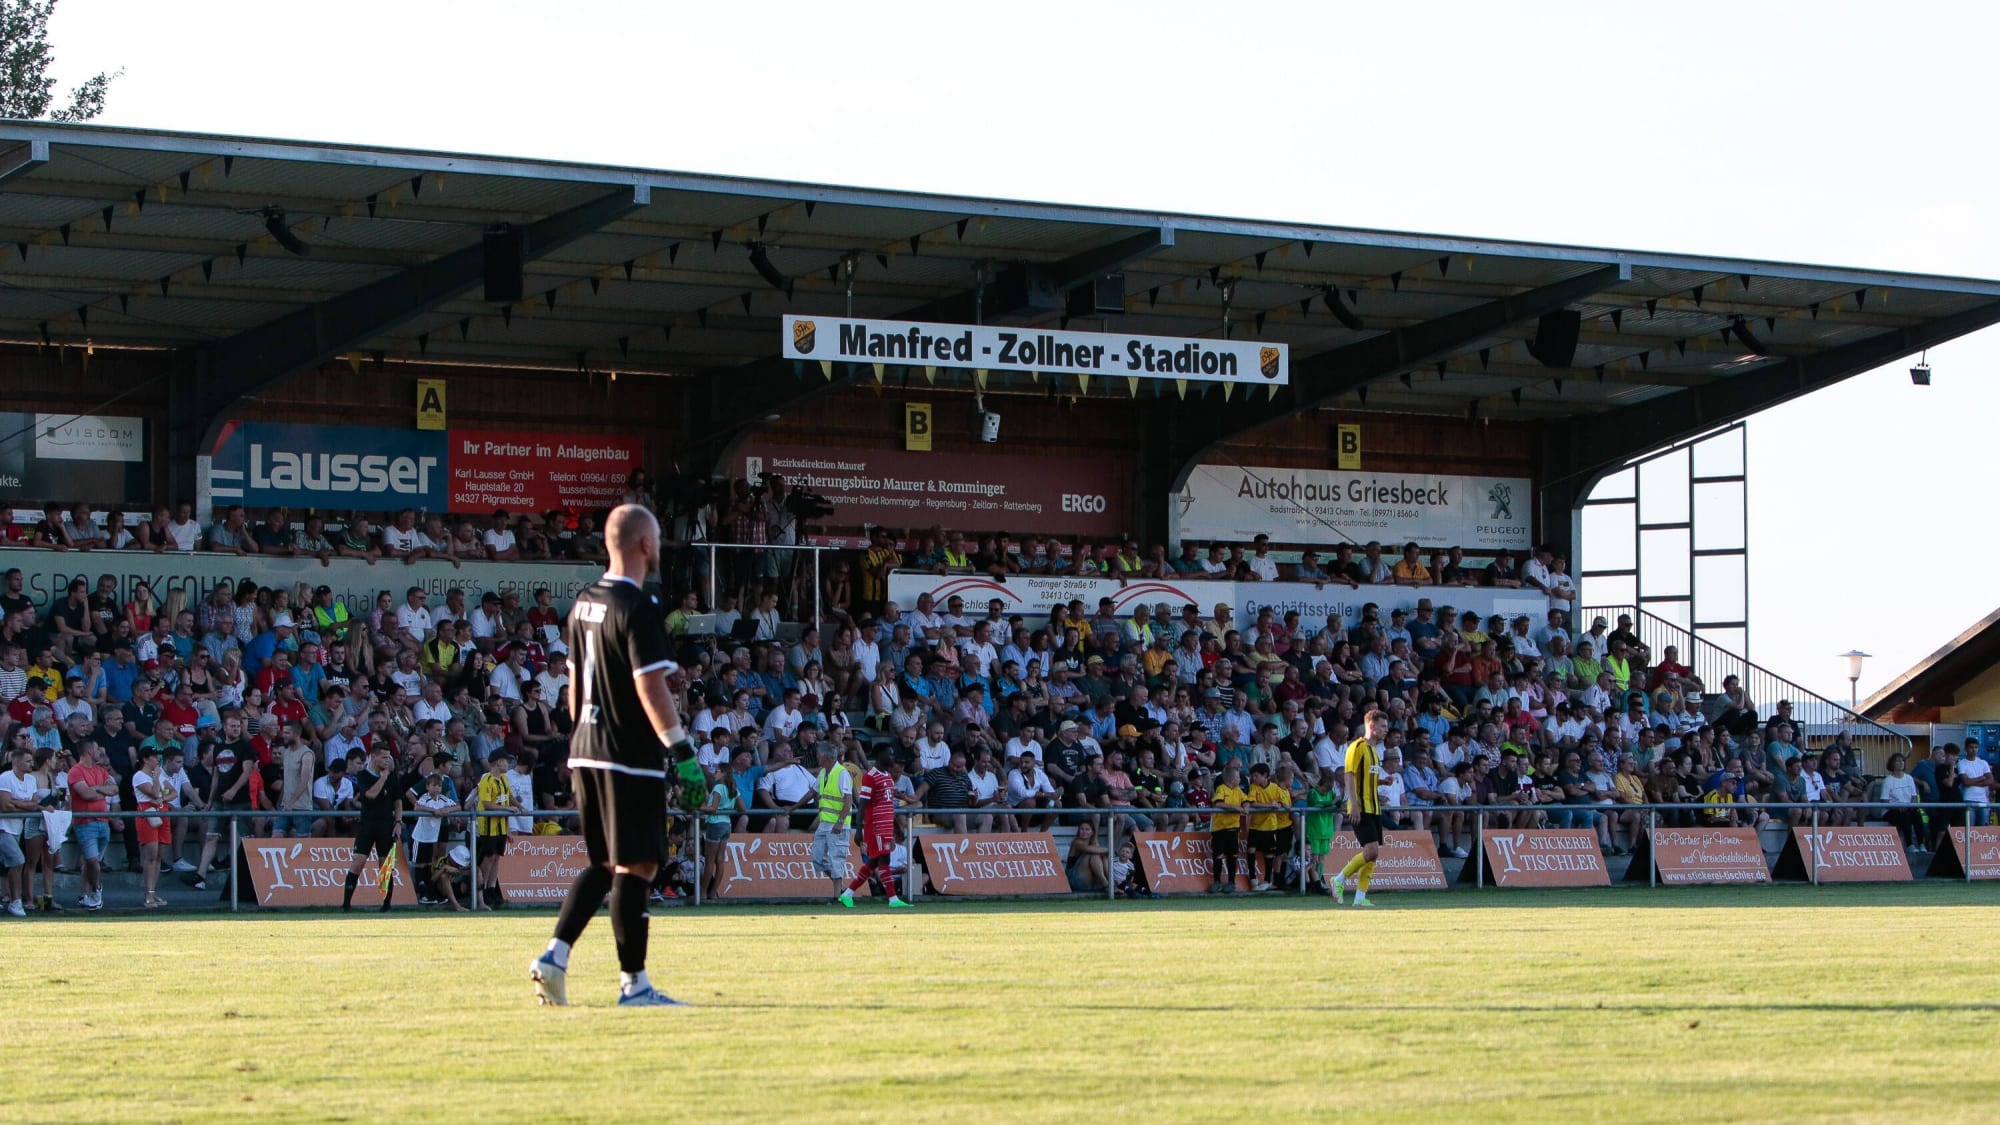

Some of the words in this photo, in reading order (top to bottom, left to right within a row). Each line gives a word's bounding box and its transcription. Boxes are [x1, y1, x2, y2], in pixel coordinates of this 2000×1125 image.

[839, 324, 973, 362] Manfred
[998, 333, 1105, 369] Zollner
[1127, 340, 1238, 376] Stadion
[420, 387, 443, 413] A
[910, 411, 928, 434] B
[64, 427, 133, 439] VISCOM
[1341, 431, 1357, 453] B
[463, 440, 480, 455] Ihr
[485, 441, 532, 457] Partner
[536, 442, 551, 458] im
[556, 444, 630, 462] Anlagenbau
[250, 443, 438, 495] Lausser
[772, 457, 836, 471] Bezirksdirektion
[455, 468, 472, 479] Karl
[474, 469, 506, 480] Lausser
[509, 470, 535, 481] GmbH
[611, 474, 626, 484] 650
[514, 482, 525, 493] 20
[772, 472, 881, 492] ersicherungsbüro
[883, 477, 925, 492] Maurer
[927, 479, 937, 492] &
[938, 480, 1006, 497] Romminger
[1237, 475, 1341, 502] Autohaus
[1347, 479, 1449, 506] Griesbeck
[454, 493, 480, 504] 94327
[482, 494, 535, 508] Pilgramsberg
[859, 494, 879, 505] David
[880, 496, 920, 509] Romminger
[926, 498, 967, 510] Regensburg
[1061, 493, 1106, 513] ERGO
[1314, 506, 1334, 515] 93413
[1335, 507, 1355, 516] Cham
[1476, 525, 1528, 535] PEUGEOT
[1027, 579, 1063, 590] Rodinger
[1063, 579, 1089, 590] Straße
[1090, 581, 1098, 590] 51
[1040, 591, 1063, 601] 93413
[1063, 591, 1086, 601] Cham
[960, 600, 1011, 610] Schlosei
[1245, 599, 1353, 617] Gechäftsstelle
[1529, 836, 1593, 850] STICKEREI
[1669, 831, 1700, 846] Partner
[1837, 833, 1896, 847] STICKEREI
[517, 840, 560, 857] Partner
[562, 843, 575, 860] für
[975, 840, 1050, 857] STICKEREI
[1519, 853, 1600, 871] TISCHLER
[1829, 850, 1902, 867] TISCHLER
[530, 865, 548, 878] und
[753, 861, 858, 881] TISCHR
[963, 859, 1057, 880] TISCHLER
[1665, 870, 1767, 881] www.stickerei-tischler.de
